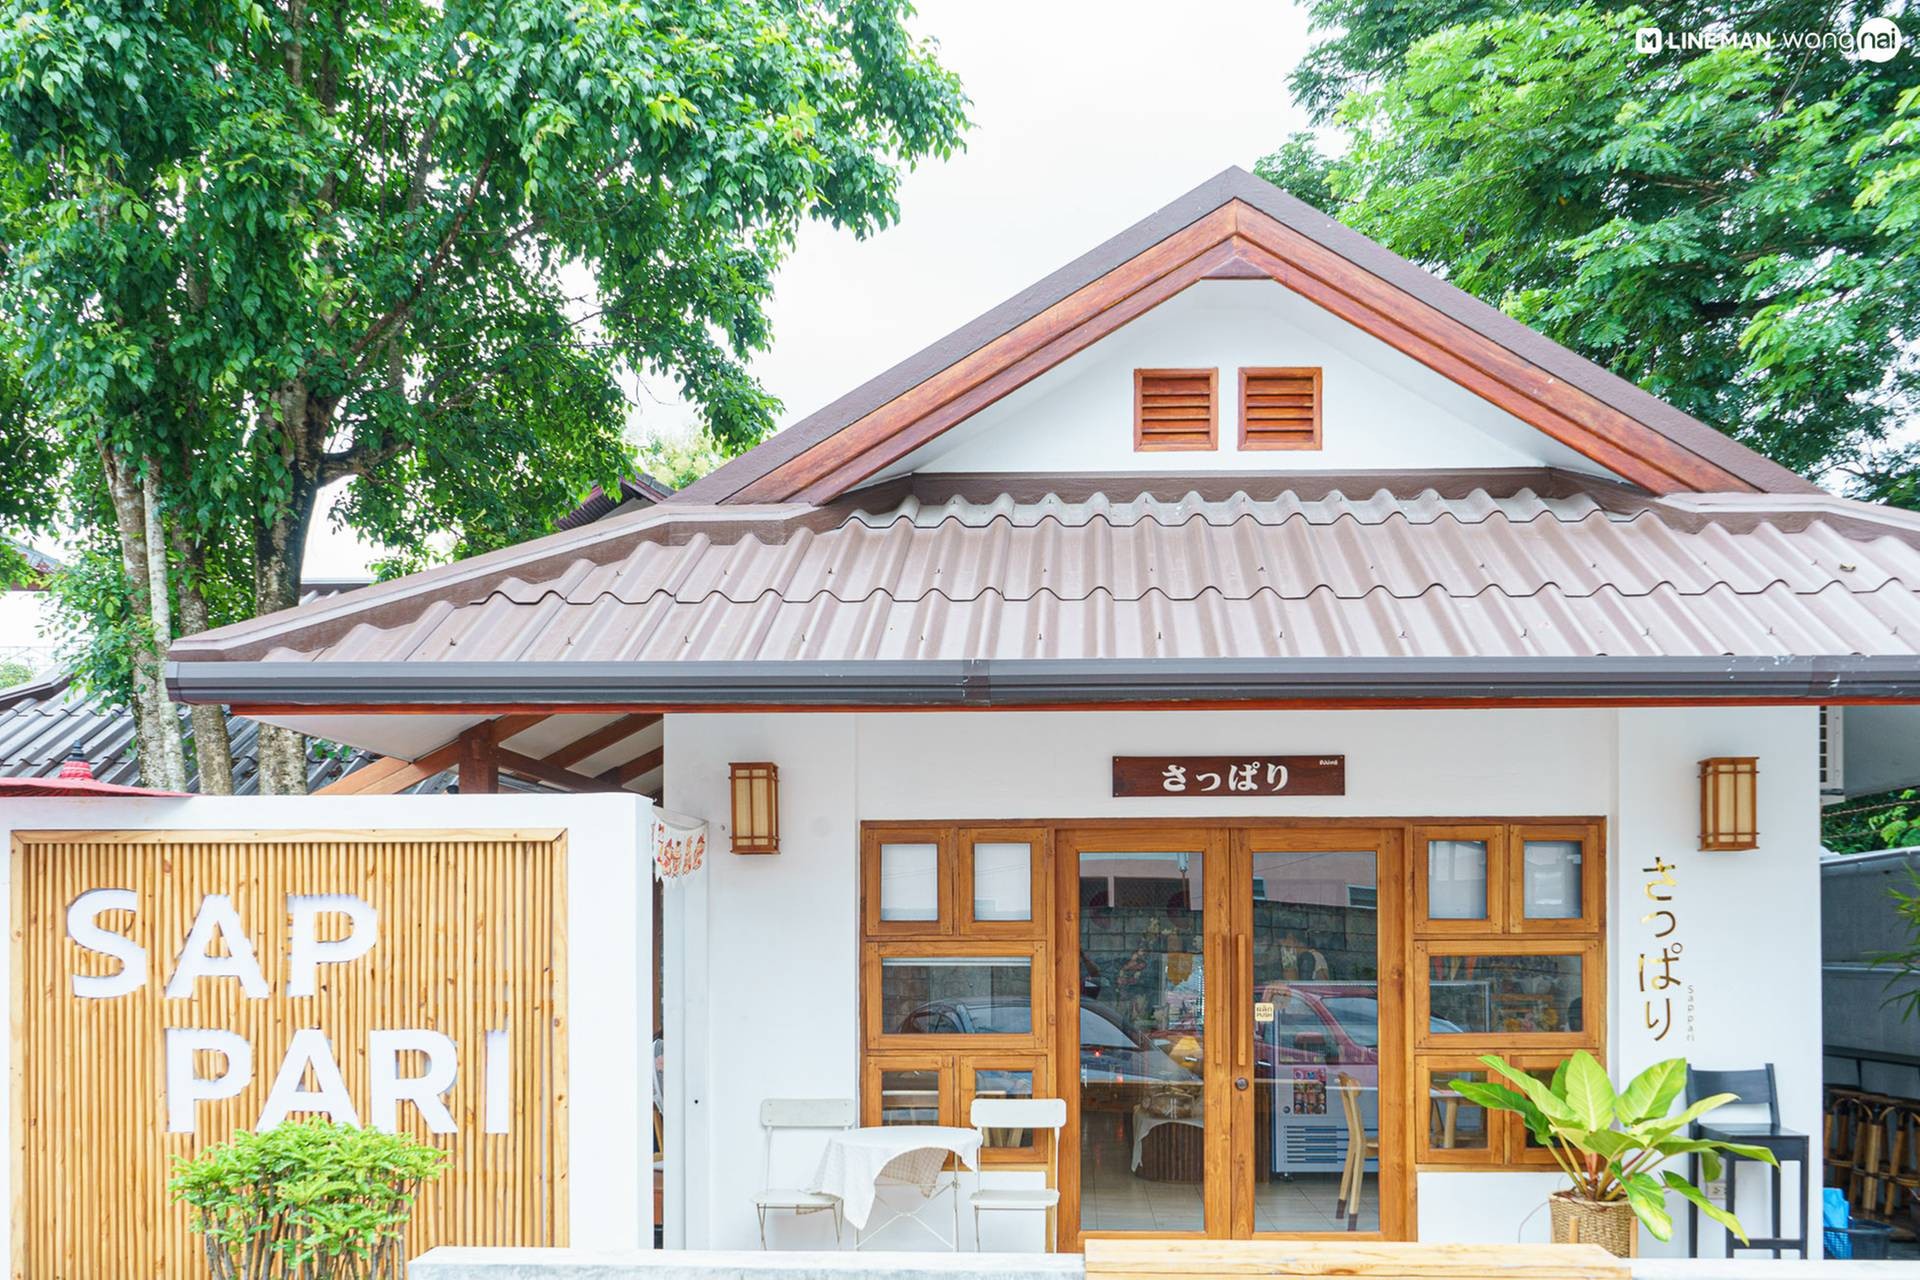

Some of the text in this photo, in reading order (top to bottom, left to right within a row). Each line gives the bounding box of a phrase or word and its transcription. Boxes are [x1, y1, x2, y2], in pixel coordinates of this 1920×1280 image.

[1162, 761, 1289, 792] さっぱり
[66, 888, 377, 999] SAP
[166, 1026, 510, 1134] PARI
